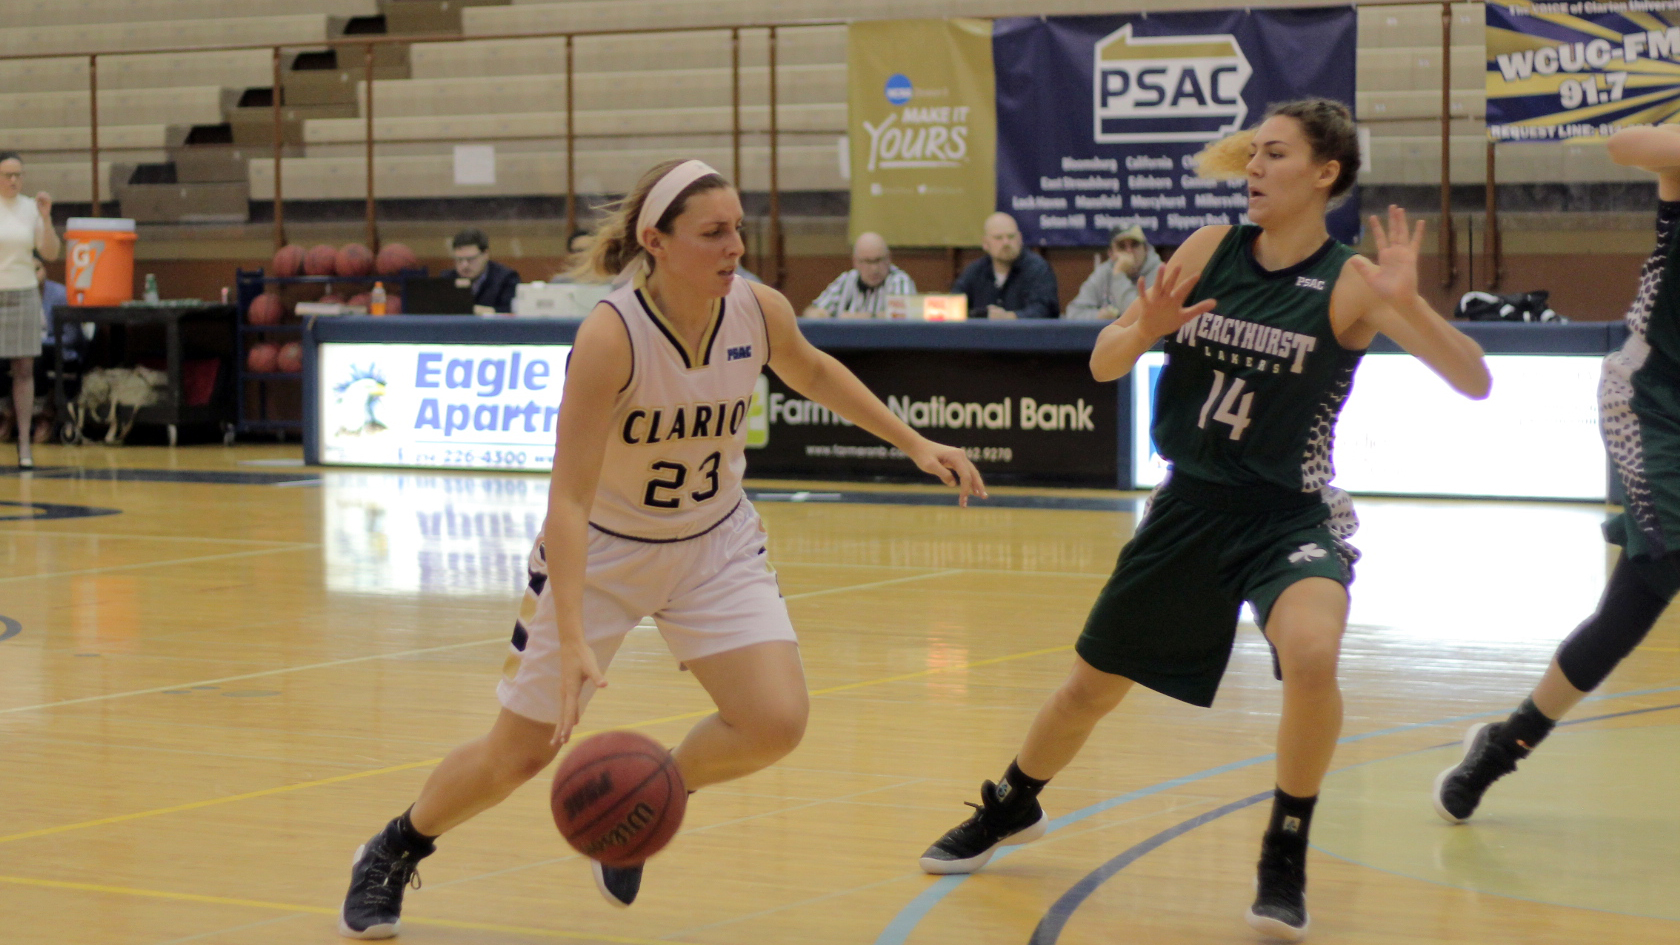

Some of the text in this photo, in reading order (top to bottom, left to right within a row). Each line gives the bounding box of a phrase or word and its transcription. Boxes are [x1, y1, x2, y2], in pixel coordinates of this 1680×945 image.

[1496, 26, 1680, 82] WCUC-FM
[1101, 66, 1237, 108] PSAC
[1559, 71, 1628, 110] 91.7
[902, 106, 971, 124] MAKE IT
[1490, 124, 1556, 140] REQUEST
[863, 113, 969, 172] YOURS
[1295, 276, 1326, 291] PSAC
[727, 345, 753, 362] PSAC
[1176, 312, 1317, 375] MERCYHURST
[1204, 345, 1281, 374] LAKERS
[414, 351, 550, 398] Eagle
[888, 396, 1012, 429] National
[1019, 397, 1094, 431] Bank
[1197, 369, 1255, 441] 14
[642, 450, 722, 509] 23
